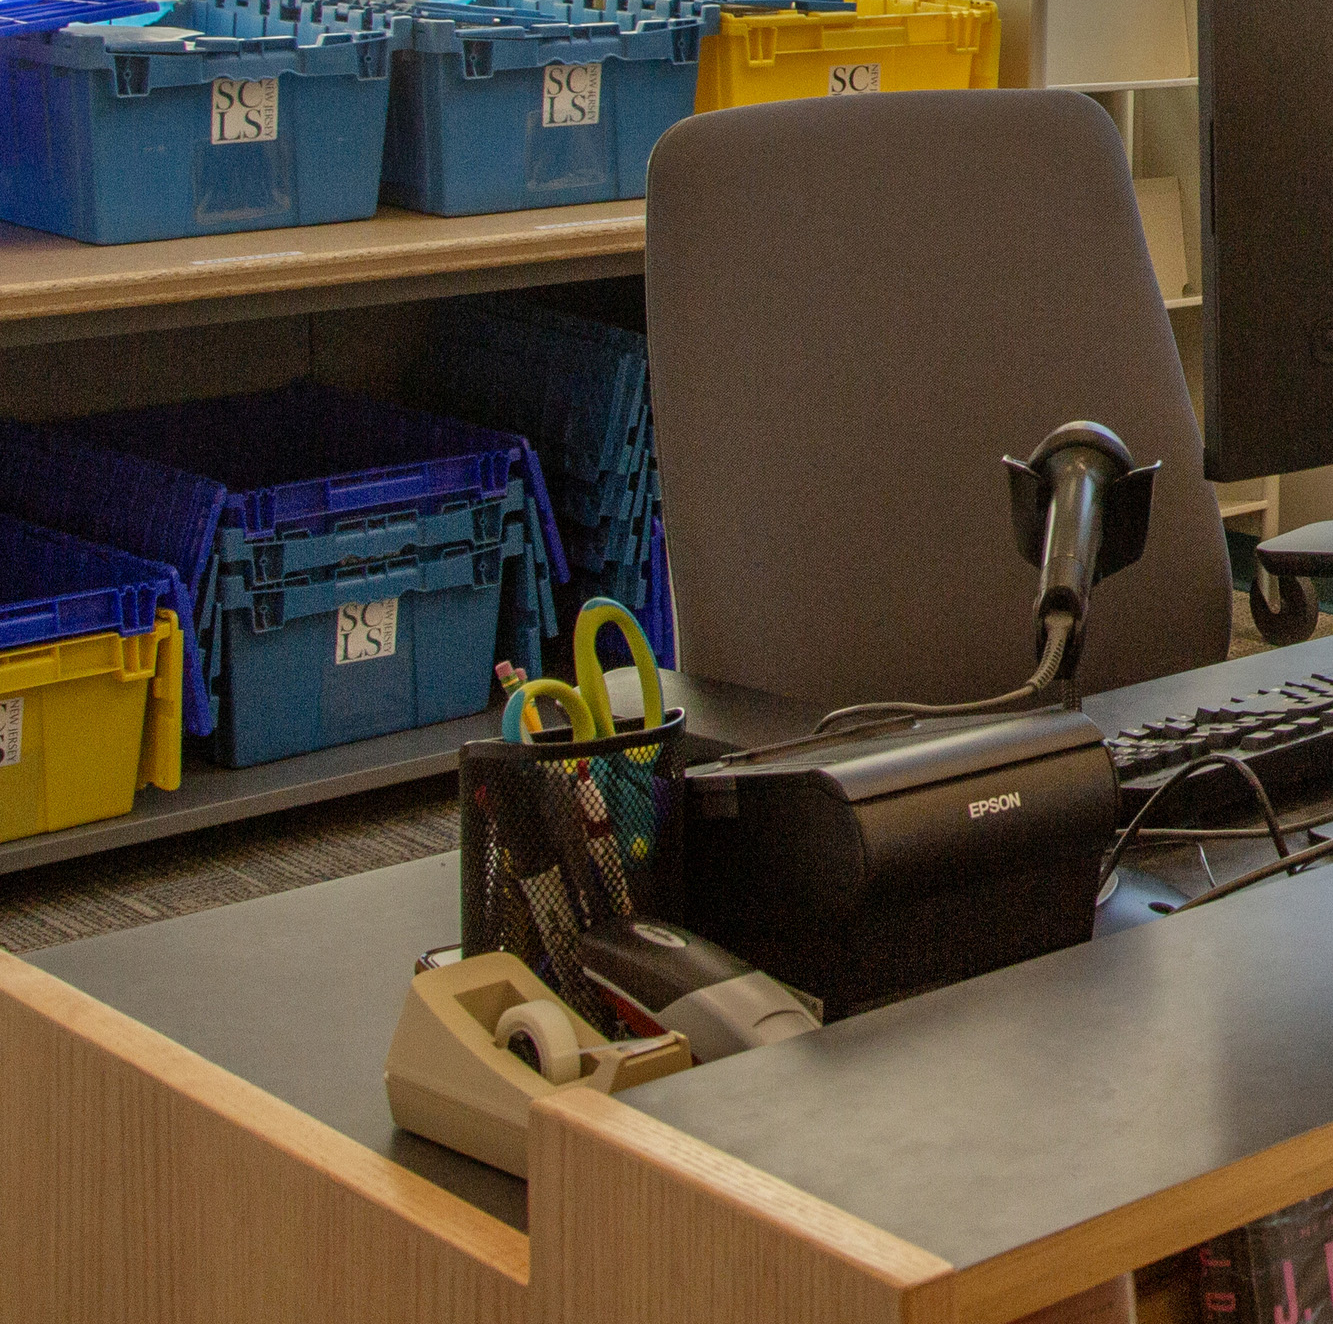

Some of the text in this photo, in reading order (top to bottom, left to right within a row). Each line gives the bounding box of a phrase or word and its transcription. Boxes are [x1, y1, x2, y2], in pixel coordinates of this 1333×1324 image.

[547, 66, 588, 95] SC
[832, 64, 870, 93] SC
[215, 79, 263, 111] SC
[545, 94, 586, 124] LS
[587, 89, 597, 123] JERSEY
[216, 109, 263, 141] LS
[262, 105, 274, 139] JERSEY
[340, 602, 385, 633] SC
[340, 629, 383, 661] LS
[383, 623, 396, 654] JERSEY
[9, 698, 20, 725] NEW
[7, 727, 19, 762] JERSEY
[968, 791, 1022, 819] EPSON
[1273, 1259, 1313, 1324] J.
